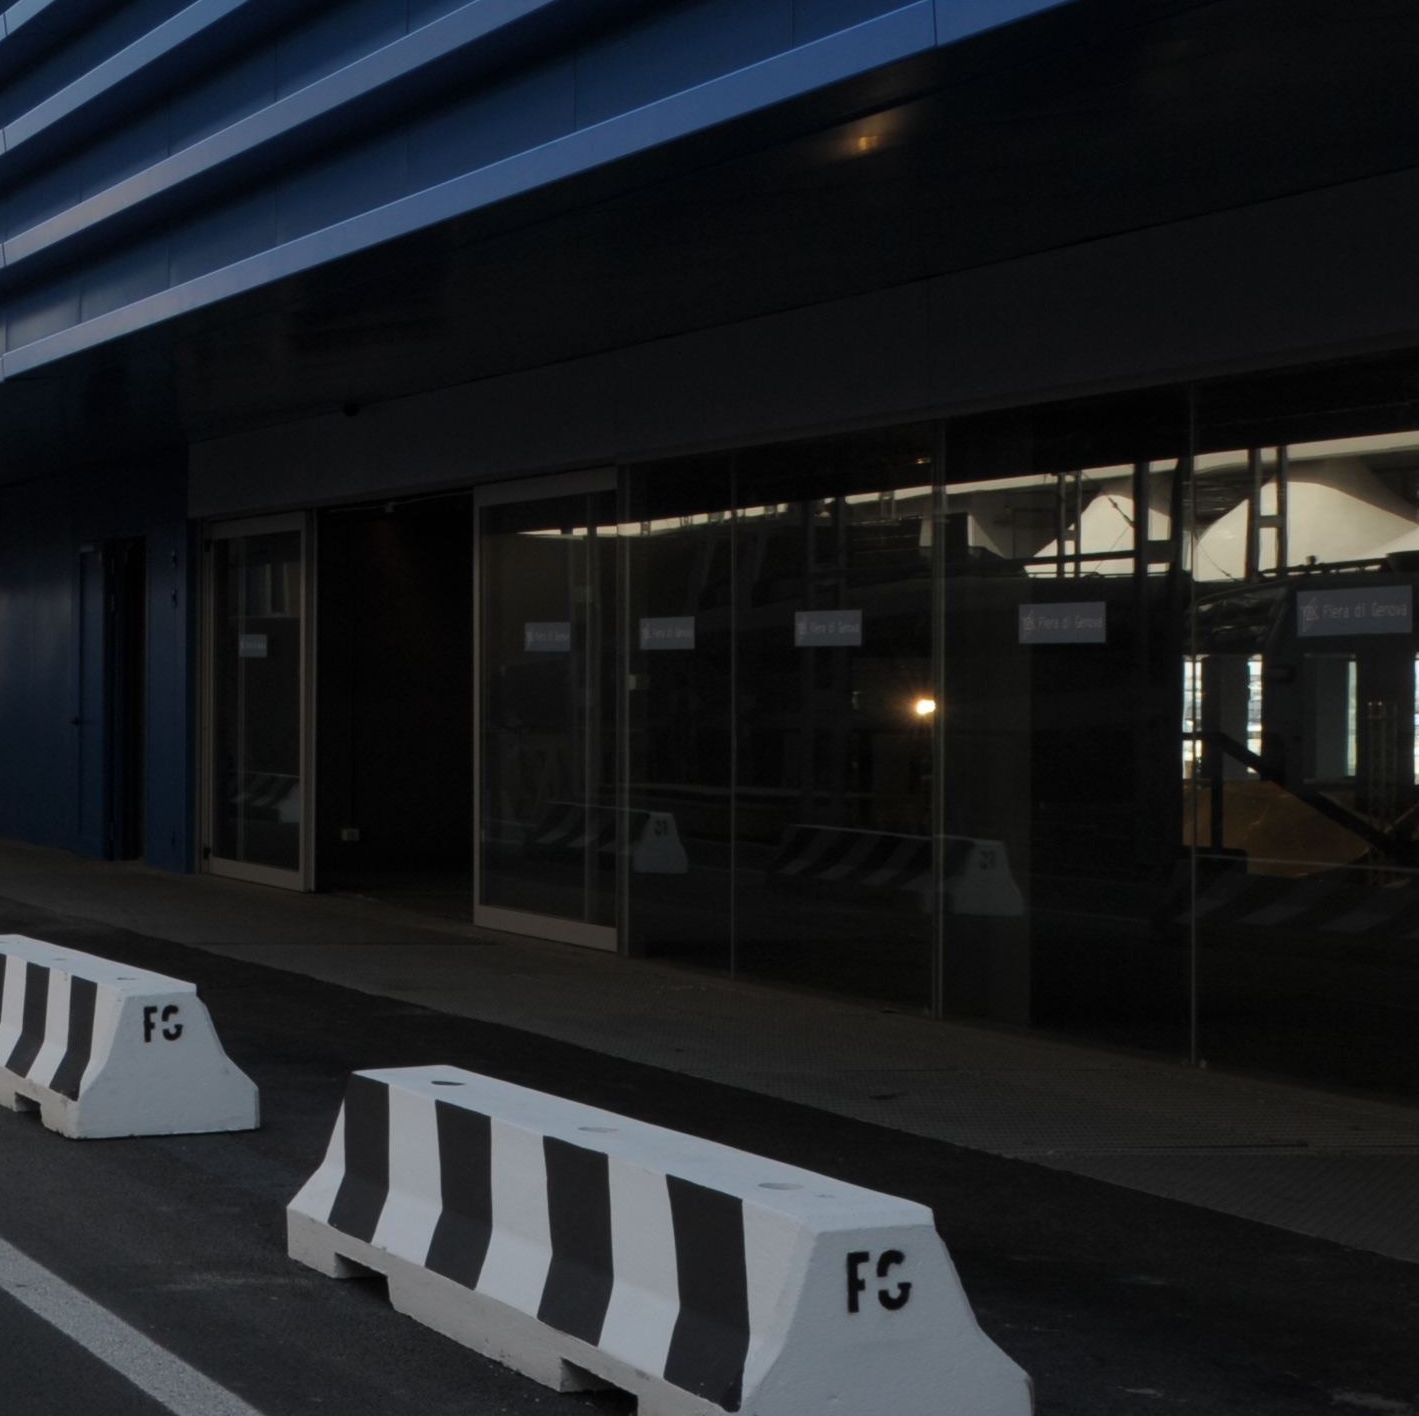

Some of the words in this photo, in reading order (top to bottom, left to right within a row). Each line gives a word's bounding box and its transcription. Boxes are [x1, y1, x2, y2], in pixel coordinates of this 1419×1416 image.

[1323, 604, 1350, 619] Fiera
[1354, 603, 1366, 618] di
[1371, 601, 1408, 617] Genova
[143, 1004, 184, 1043] FG
[846, 1249, 912, 1313] FG
